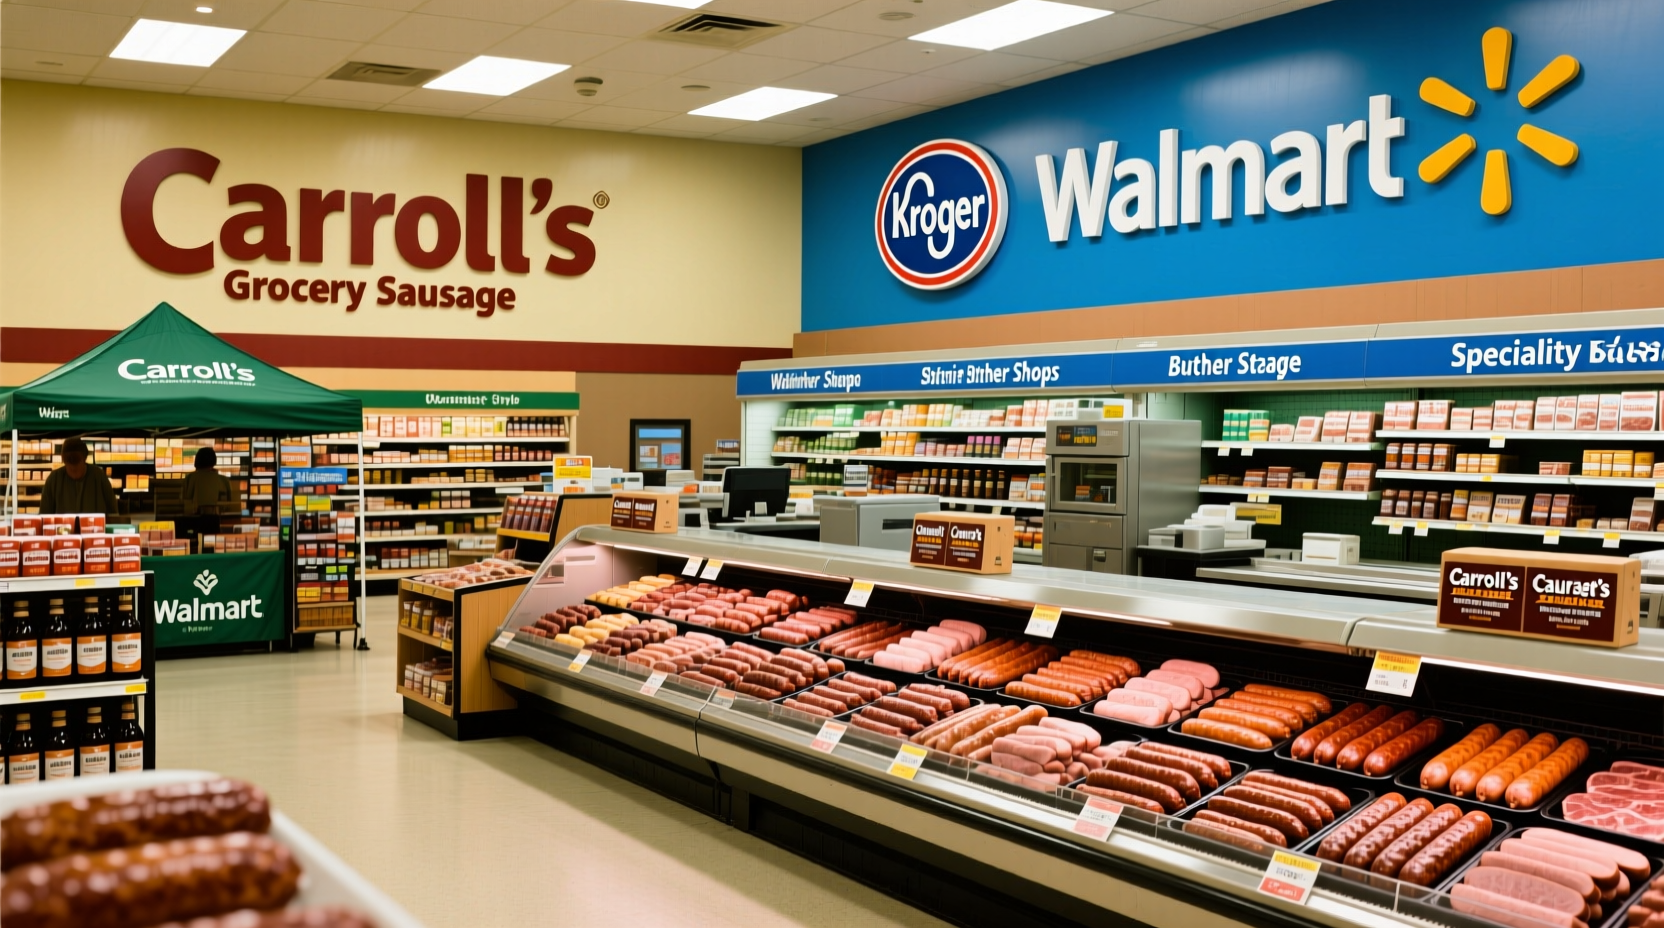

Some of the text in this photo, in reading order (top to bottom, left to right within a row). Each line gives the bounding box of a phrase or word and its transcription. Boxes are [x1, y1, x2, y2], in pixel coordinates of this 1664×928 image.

[1035, 94, 1405, 243] Walmart
[120, 147, 596, 276] Carroll's
[891, 171, 986, 260] Kroger
[223, 269, 516, 317] Grocery Sausage
[117, 358, 256, 382] Carroll's
[1168, 352, 1233, 377] Buther
[1450, 337, 1583, 374] Speciality
[1013, 361, 1060, 388] Shops
[1449, 567, 1519, 591] Carroll's
[153, 594, 263, 625] Walmart
